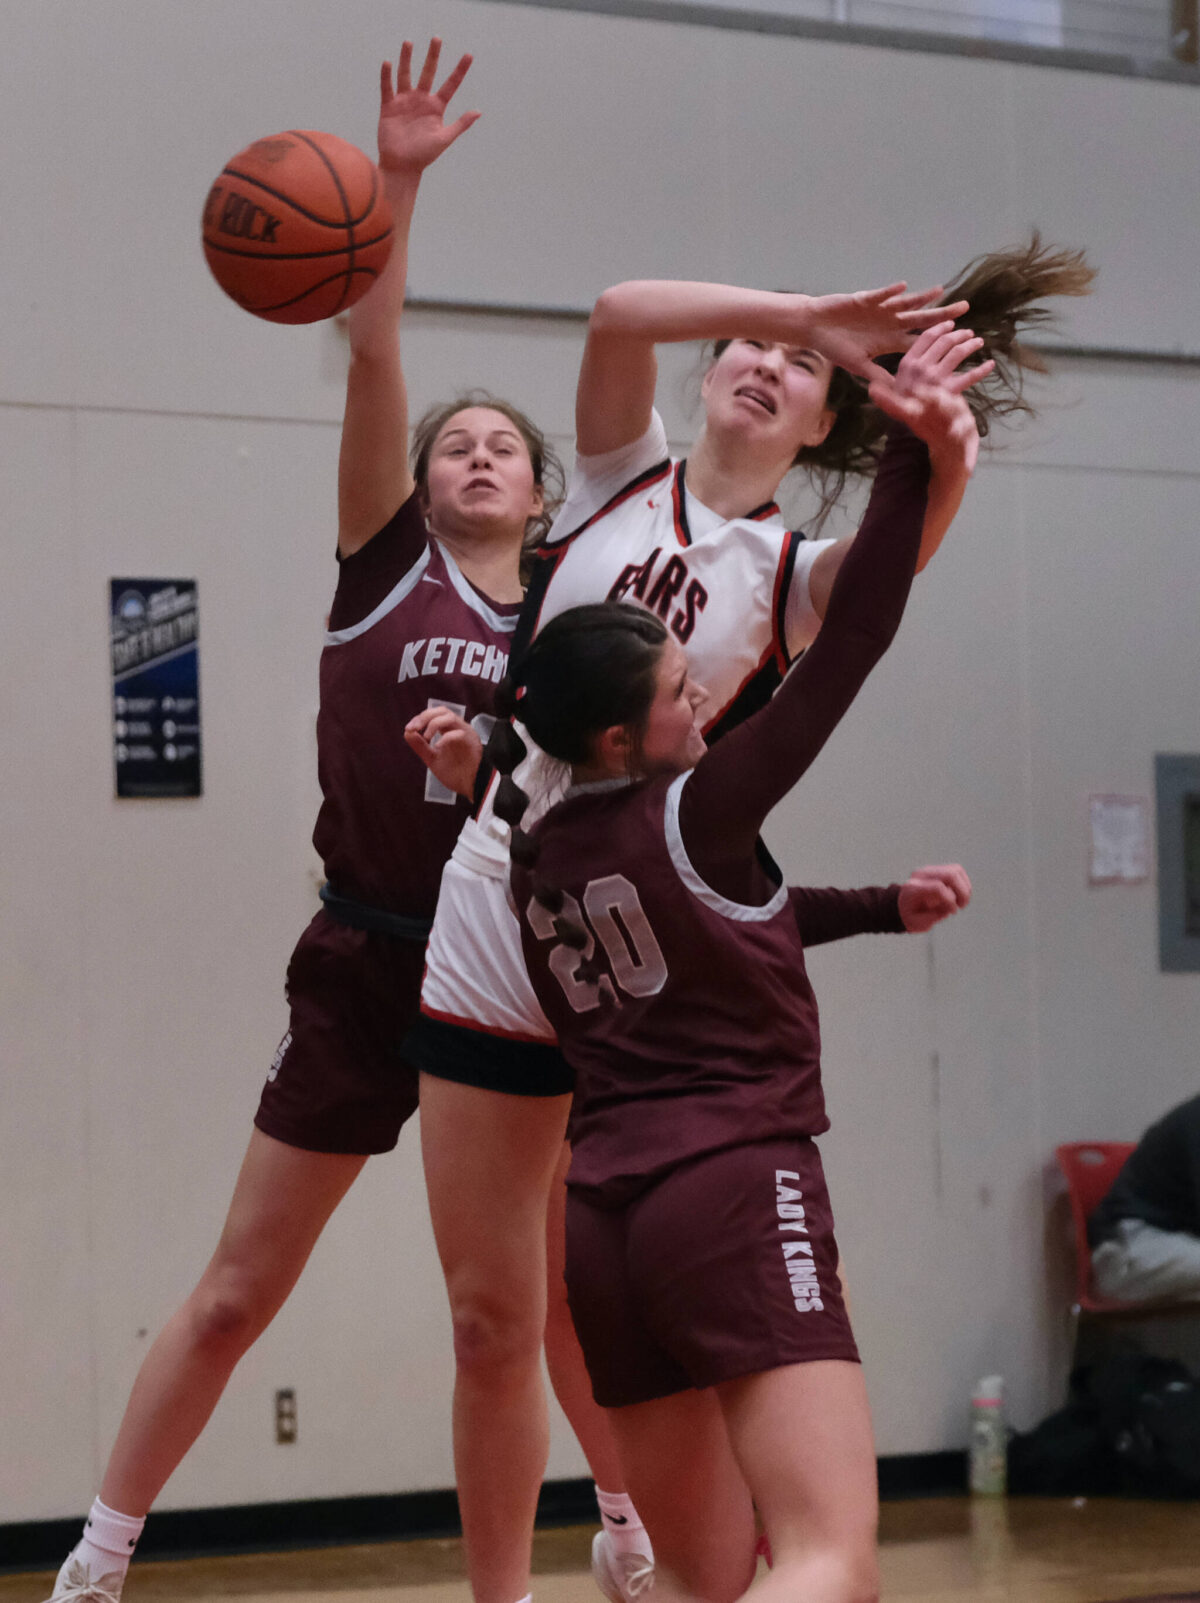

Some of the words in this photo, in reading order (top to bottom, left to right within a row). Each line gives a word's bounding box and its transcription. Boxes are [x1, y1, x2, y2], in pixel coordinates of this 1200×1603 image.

[526, 873, 668, 1014] 20
[775, 1169, 809, 1234] LADY
[781, 1241, 825, 1313] KINGS
